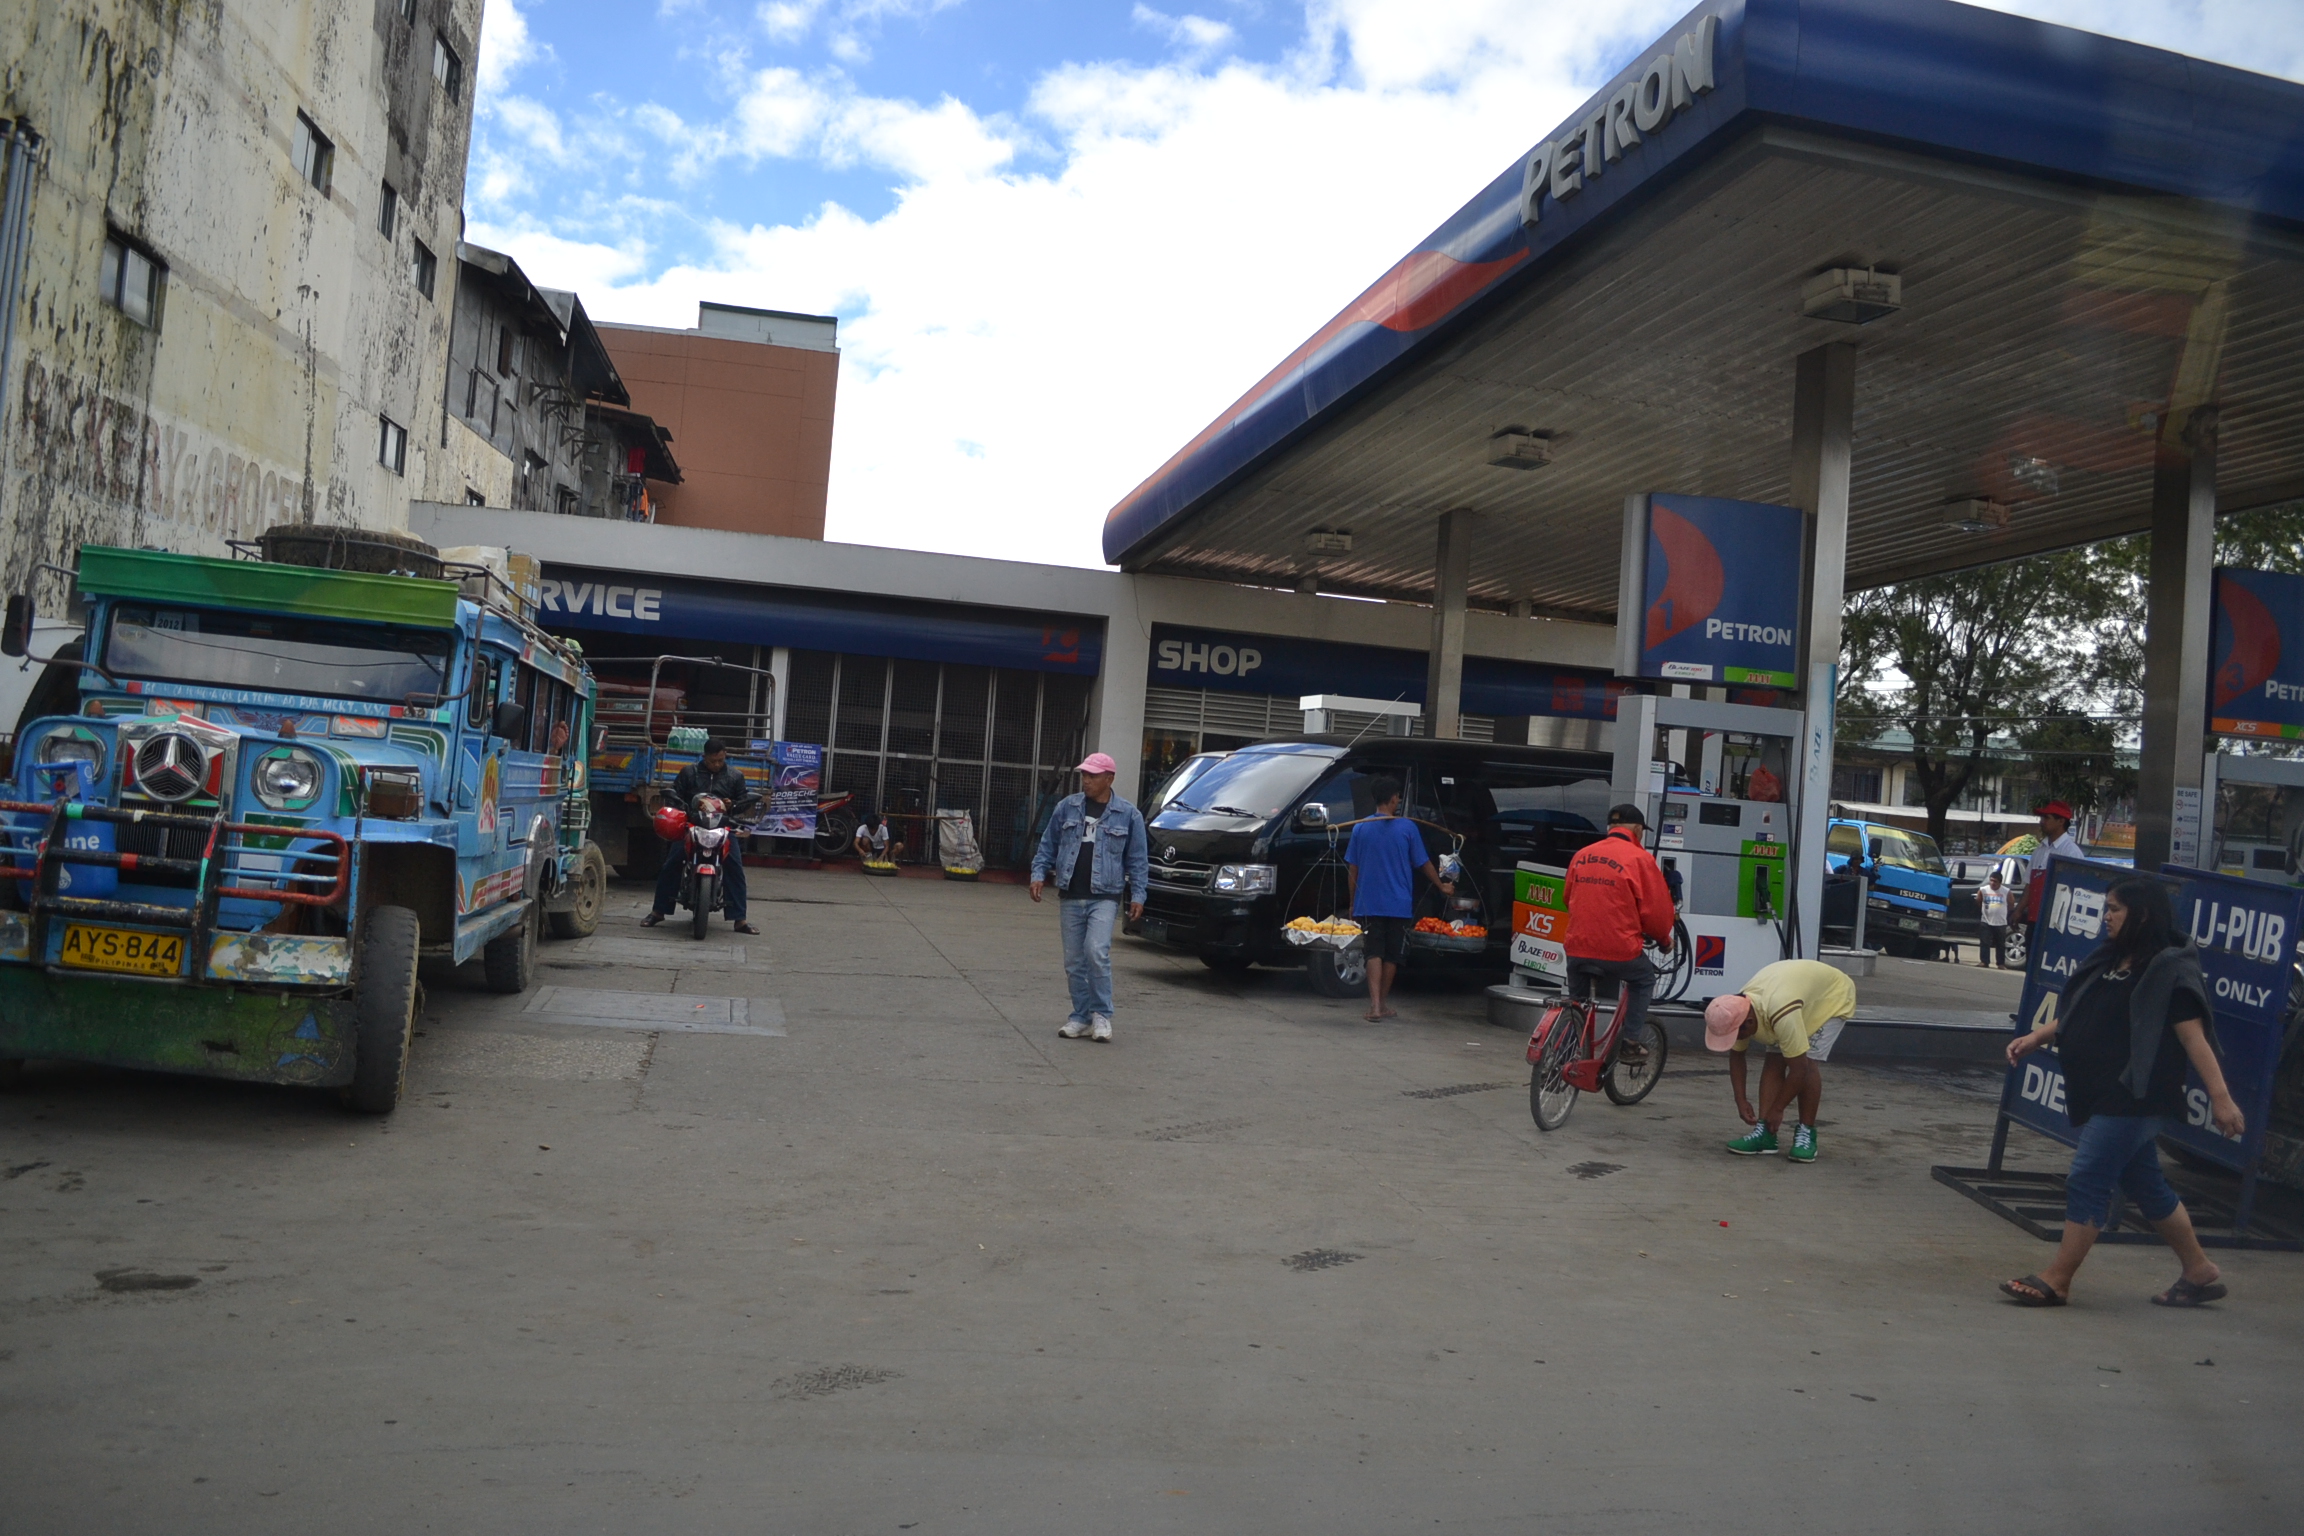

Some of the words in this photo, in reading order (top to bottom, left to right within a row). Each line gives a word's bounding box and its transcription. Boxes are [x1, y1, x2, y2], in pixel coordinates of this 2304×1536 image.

[1521, 14, 1719, 228] PETRON
[538, 578, 662, 621] RVICE
[157, 618, 180, 630] 2012
[1659, 598, 1674, 631] 1
[1706, 618, 1792, 646] PETRON
[1157, 639, 1262, 677] SHOP
[2226, 662, 2244, 692] 3
[2234, 722, 2257, 732] XCS
[776, 789, 817, 798] PORSCHE
[1575, 853, 1625, 873] Nissen
[1575, 874, 1616, 887] Logistics
[1899, 889, 1927, 901] ISUZU
[1526, 910, 1555, 934] XCS
[1694, 967, 1724, 976] PETRON
[2040, 950, 2081, 977] LAN
[2215, 976, 2272, 1008] ONLY
[2020, 1063, 2069, 1116] DIE
